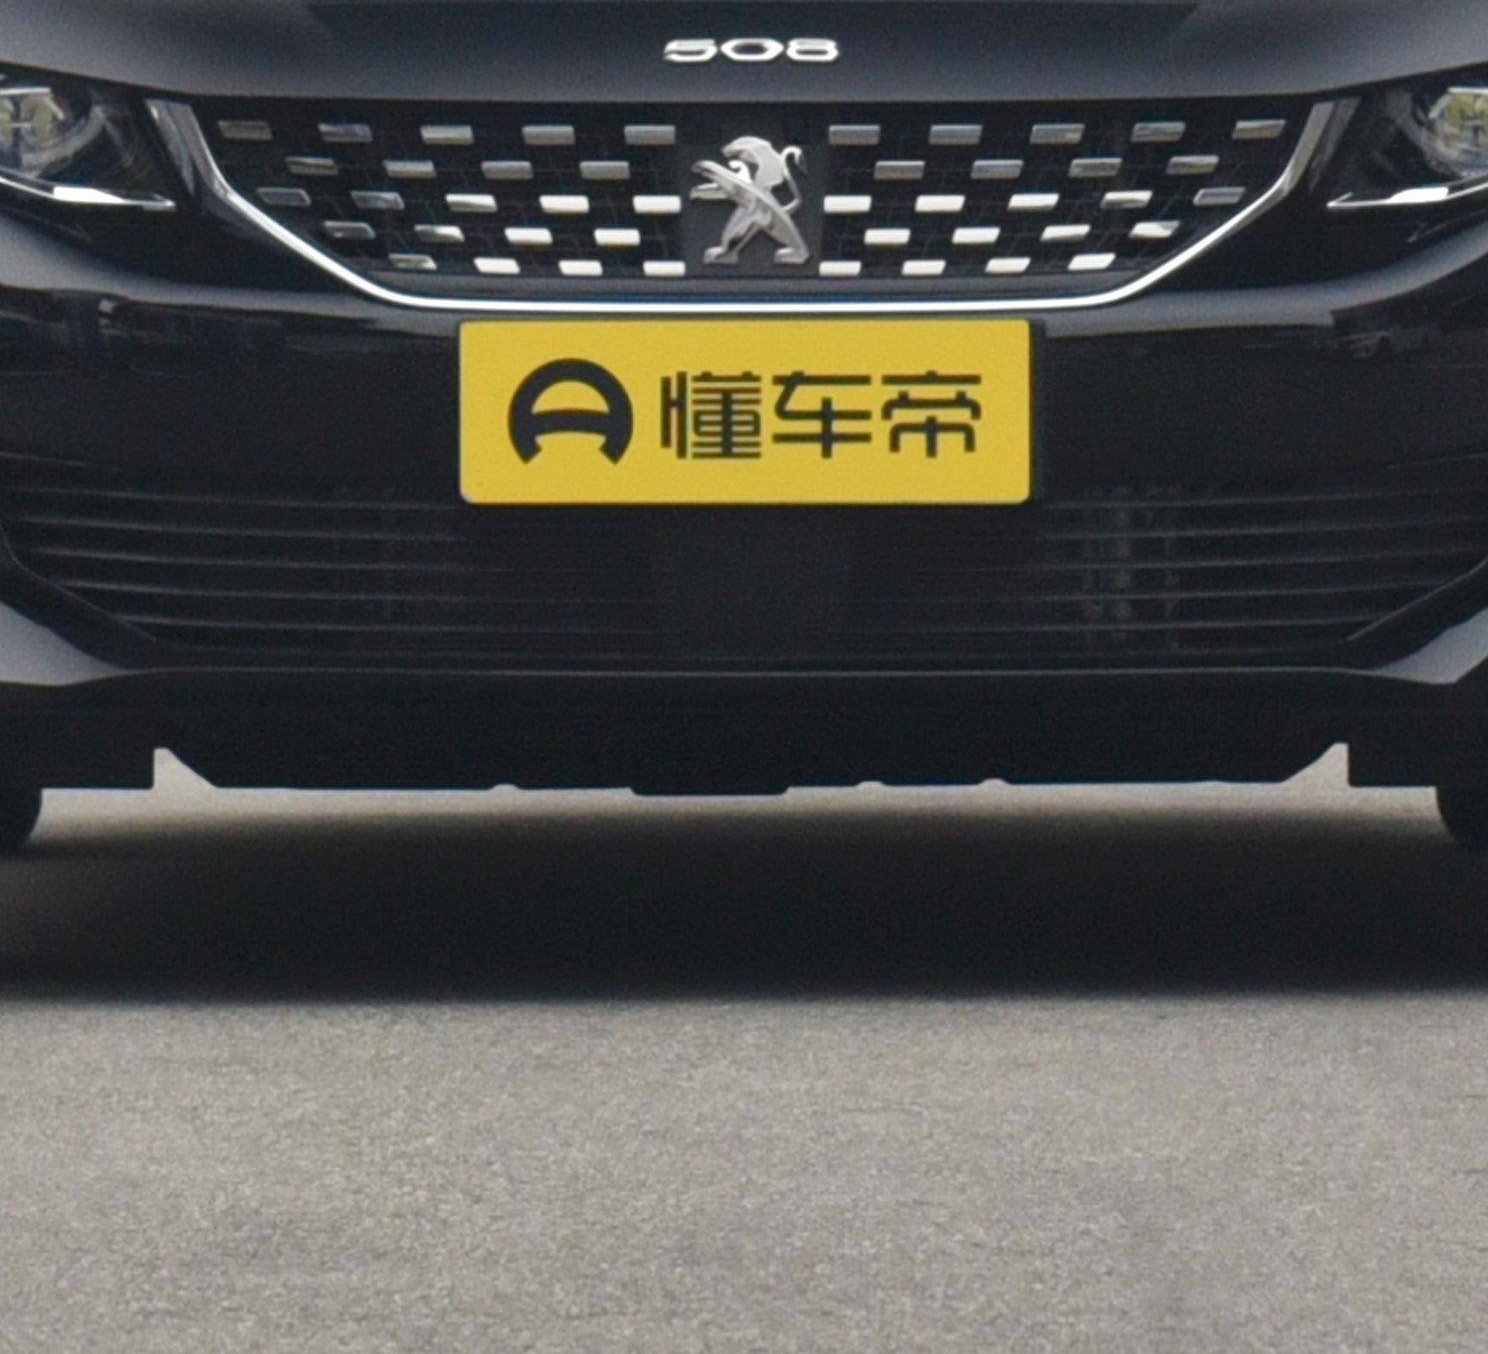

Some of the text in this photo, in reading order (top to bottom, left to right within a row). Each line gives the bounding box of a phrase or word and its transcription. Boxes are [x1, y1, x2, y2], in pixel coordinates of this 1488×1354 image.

[662, 37, 840, 63] 508
[660, 370, 983, 460] 懂车帝
